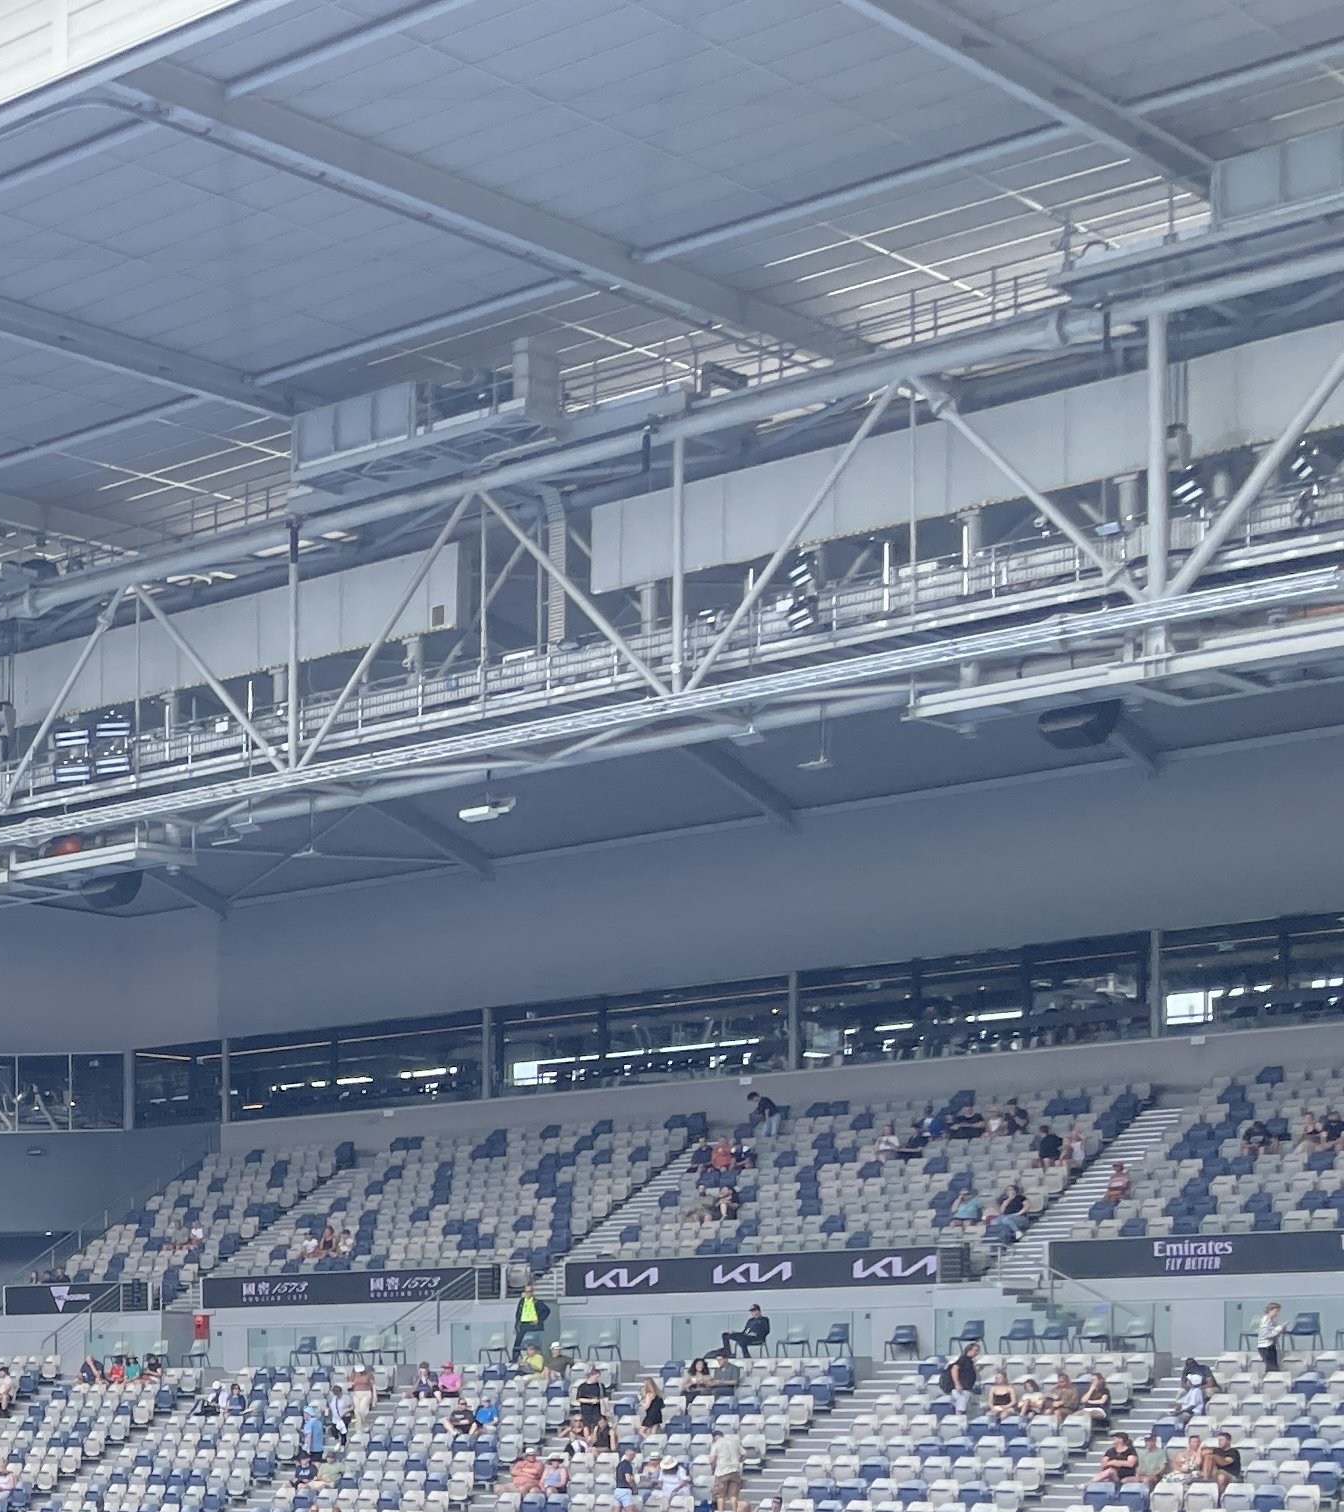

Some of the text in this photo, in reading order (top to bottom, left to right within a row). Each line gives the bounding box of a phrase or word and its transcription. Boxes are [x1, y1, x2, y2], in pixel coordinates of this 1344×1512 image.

[1153, 1240, 1232, 1257] Emirates
[1165, 1256, 1221, 1271] FLY BETTER
